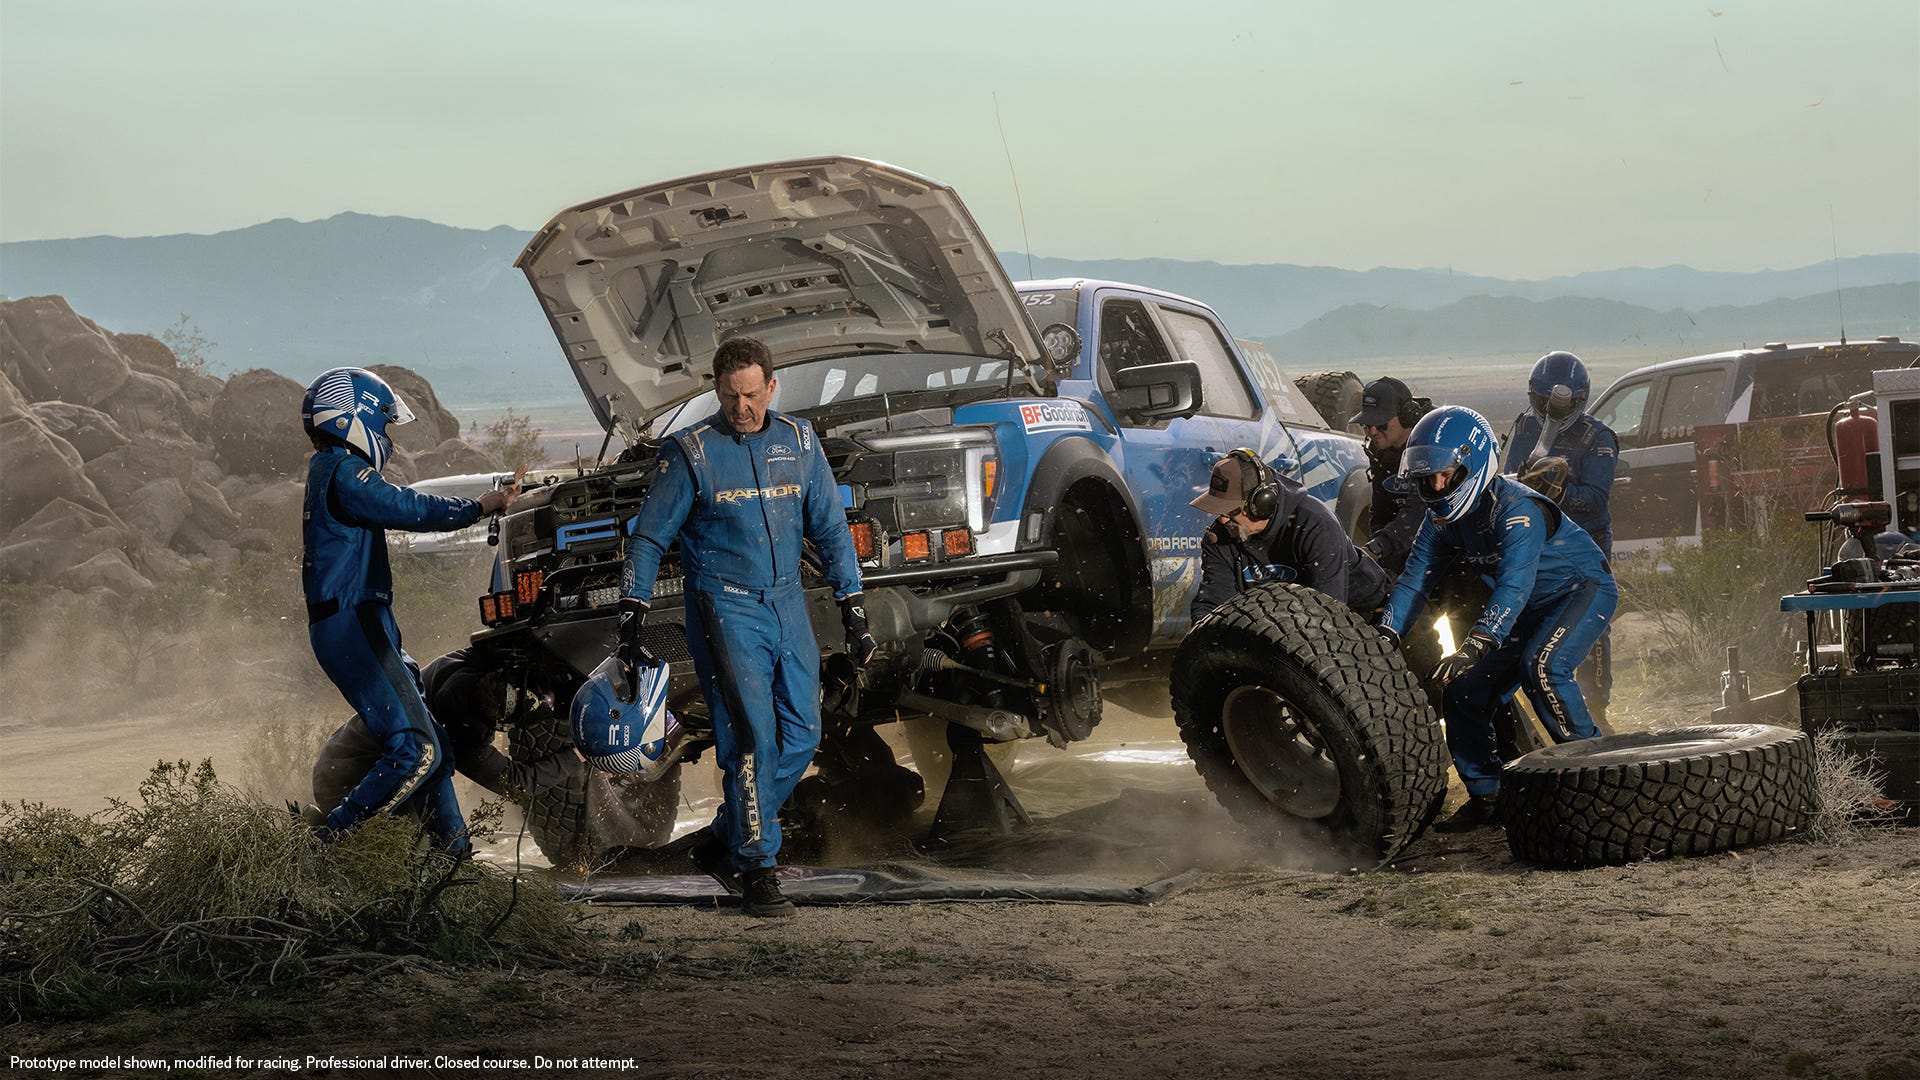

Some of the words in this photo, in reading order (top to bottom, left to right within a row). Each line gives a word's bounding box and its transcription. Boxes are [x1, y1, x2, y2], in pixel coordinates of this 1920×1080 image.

[1020, 403, 1089, 425] BFGoodrich
[716, 485, 800, 506] RAPTOR
[1146, 537, 1171, 551] ORD
[1172, 536, 1203, 550] RACI
[1537, 626, 1567, 691] RACING
[738, 753, 761, 847] RAPTOR
